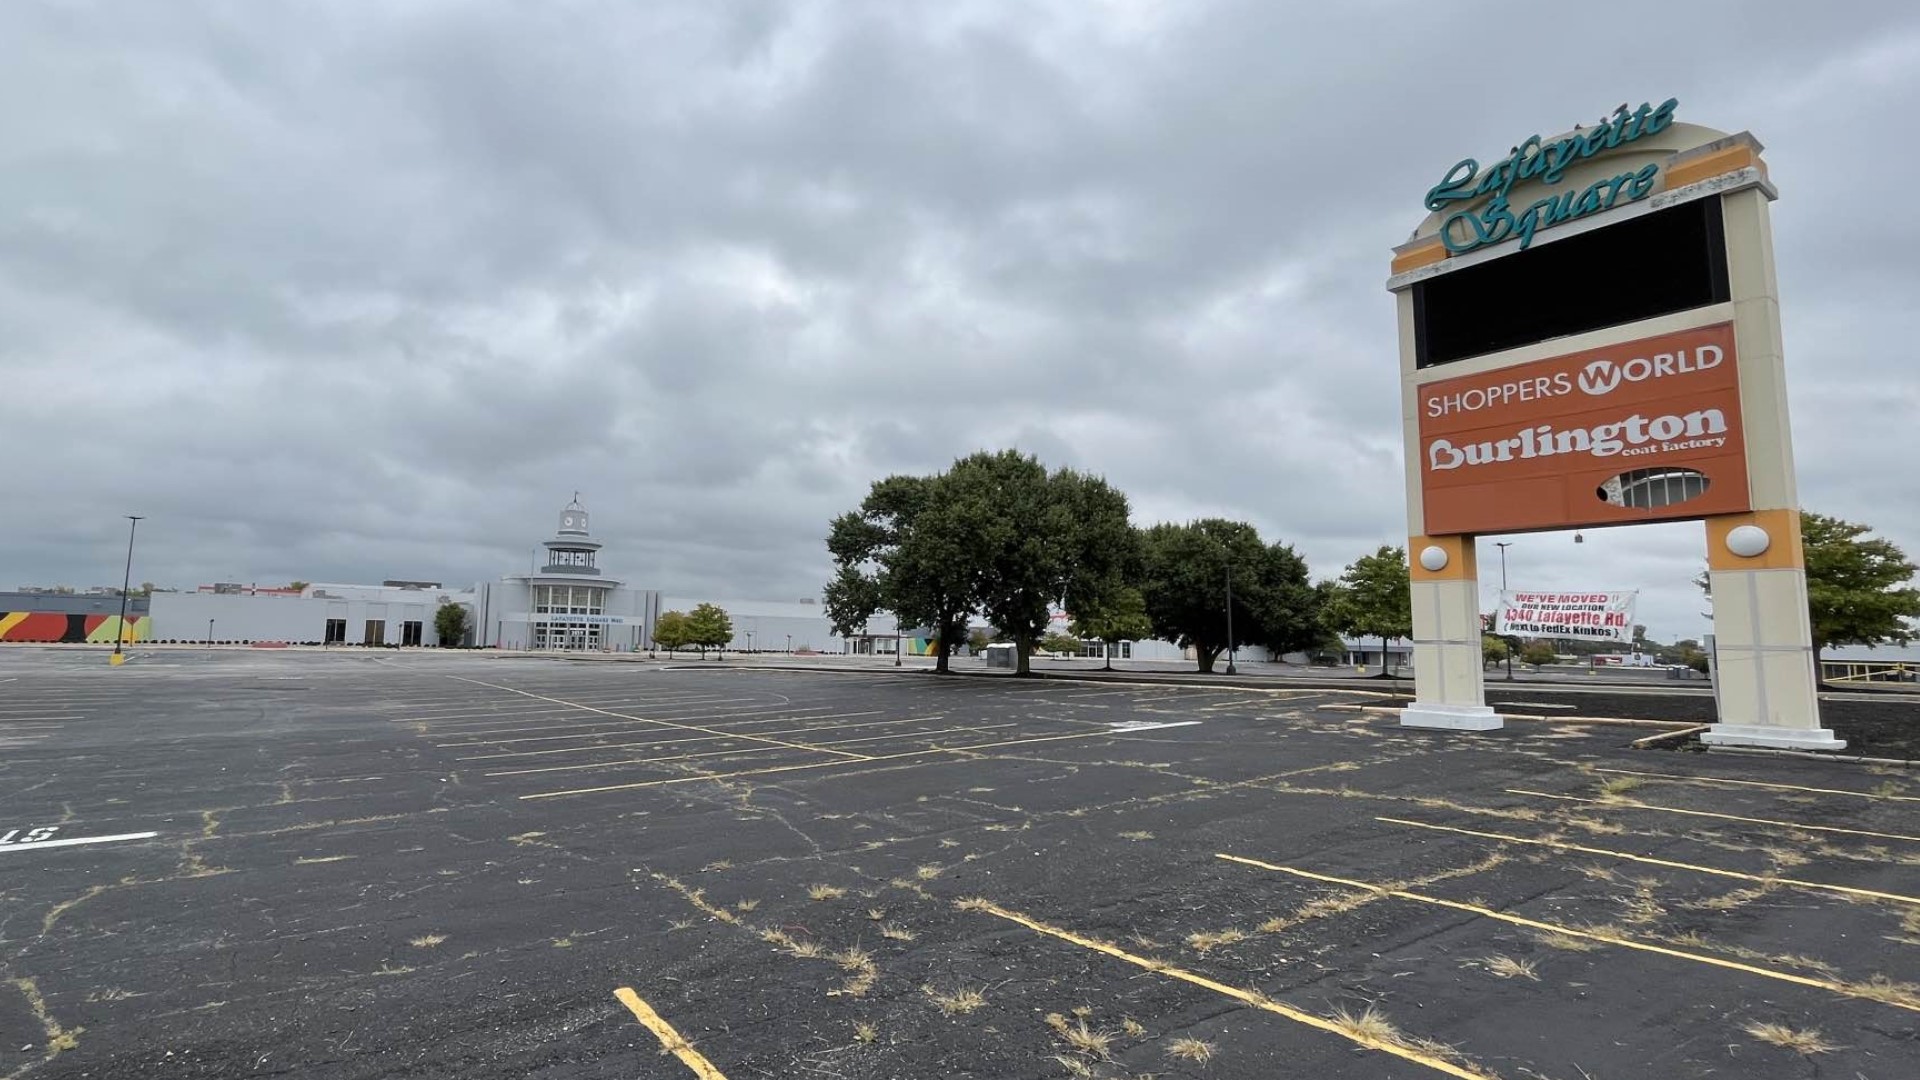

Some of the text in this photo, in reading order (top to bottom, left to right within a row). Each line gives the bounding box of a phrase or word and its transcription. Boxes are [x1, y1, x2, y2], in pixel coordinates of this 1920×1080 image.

[1424, 97, 1679, 211] Lafayette
[1440, 163, 1659, 252] Square
[1427, 345, 1723, 417] SHOPPERS WORLD
[1430, 408, 1728, 471] Burlington
[1622, 436, 1726, 457] coat factory
[1504, 609, 1532, 621] 4340
[1537, 611, 1600, 625] Lafayette
[1515, 594, 1555, 603] WE'VE
[1558, 595, 1608, 603] MOVED
[1542, 624, 1570, 633] FedEx
[1573, 627, 1611, 636] Kinkos
